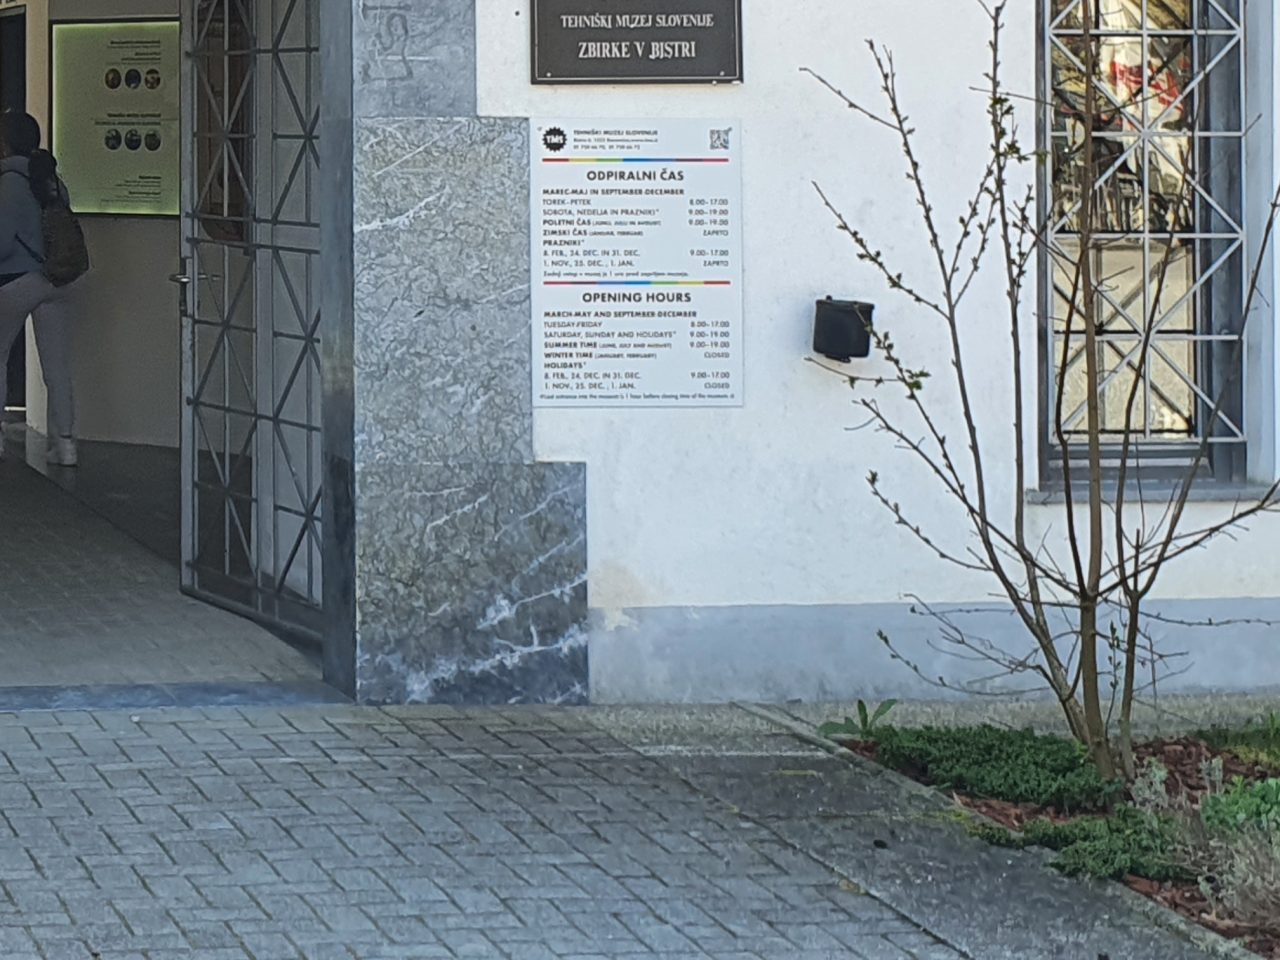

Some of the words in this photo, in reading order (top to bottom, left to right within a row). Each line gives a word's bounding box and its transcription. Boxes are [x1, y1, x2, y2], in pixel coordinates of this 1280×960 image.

[560, 13, 612, 28] TEHNIŠKI
[616, 15, 652, 28] MUZEJ
[656, 14, 714, 27] SLOVENIJE
[578, 42, 630, 58] ZBIRKE
[634, 42, 645, 57] V
[649, 41, 696, 59] BISTRI
[587, 171, 656, 181] ODPIRALNI
[660, 168, 684, 181] ČAS
[572, 228, 587, 236] ČAS
[582, 292, 642, 303] OPENING
[646, 292, 691, 302] HOURS
